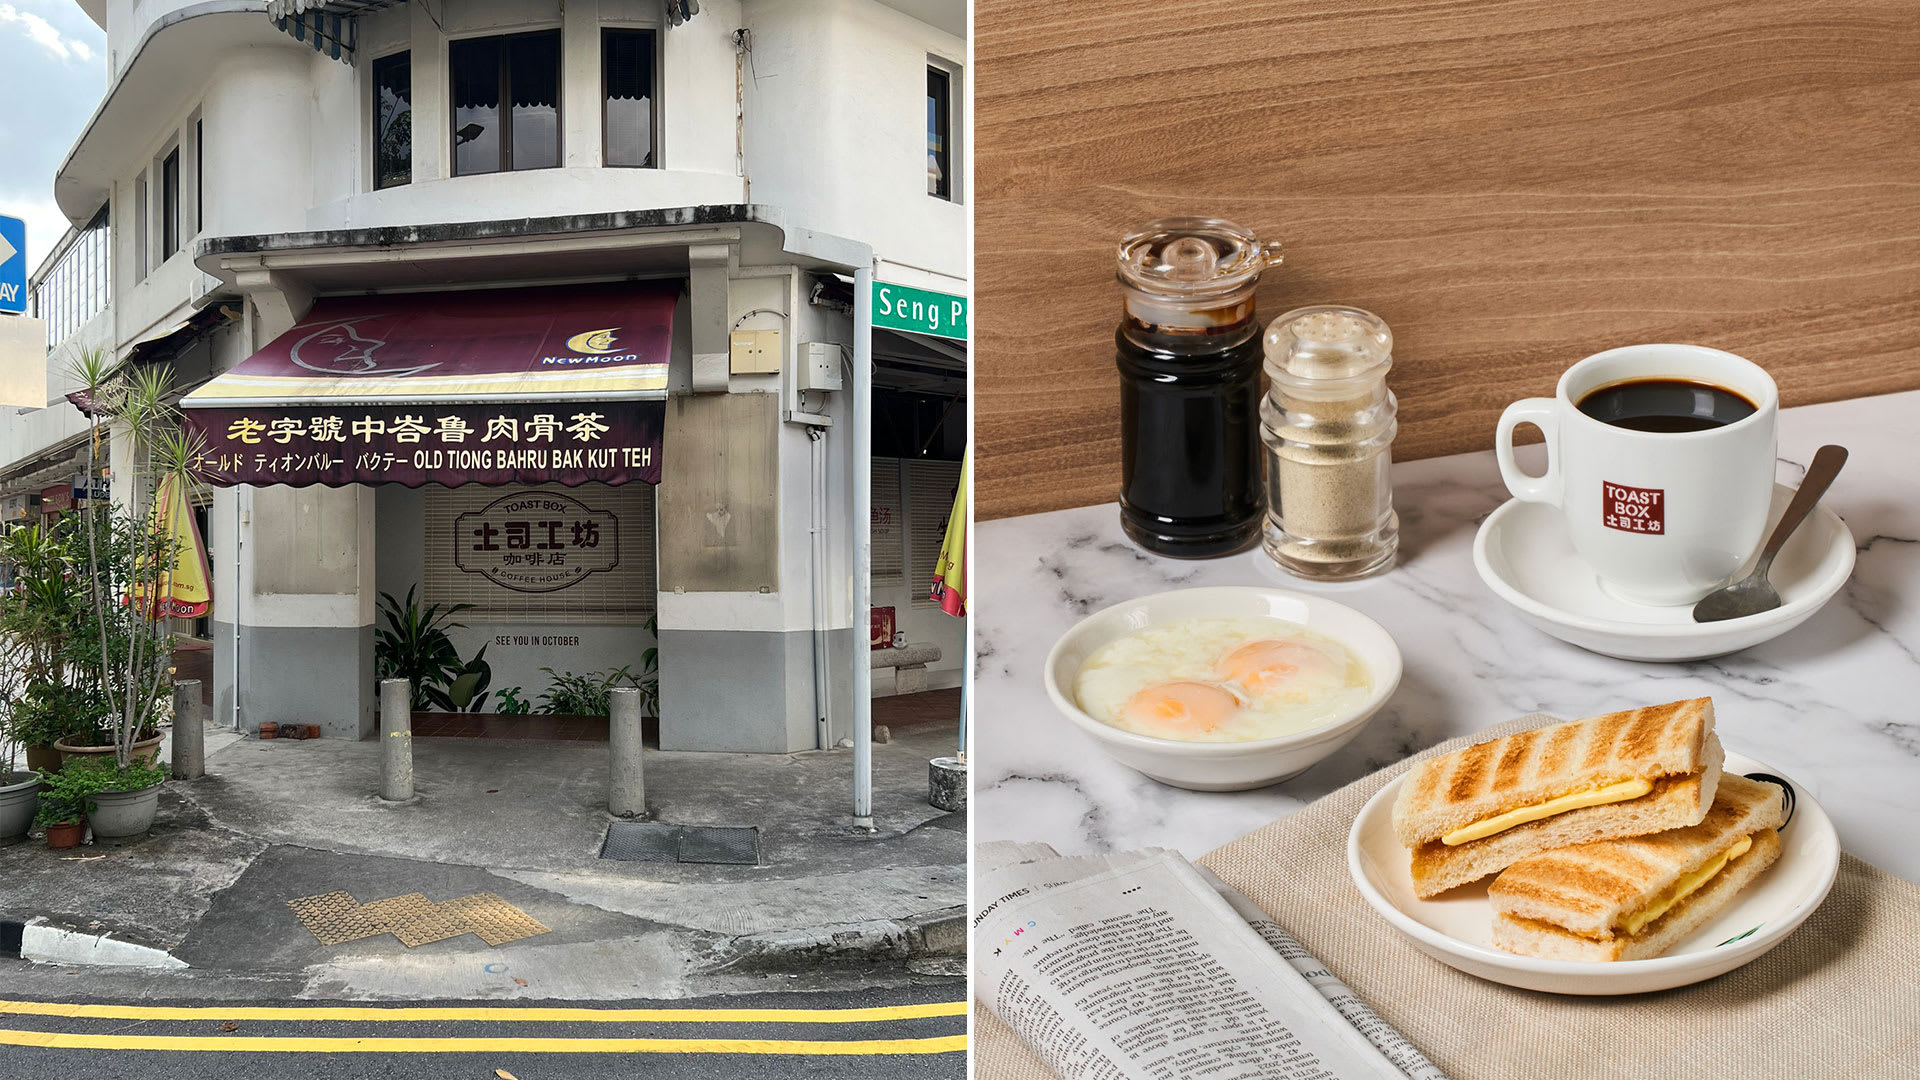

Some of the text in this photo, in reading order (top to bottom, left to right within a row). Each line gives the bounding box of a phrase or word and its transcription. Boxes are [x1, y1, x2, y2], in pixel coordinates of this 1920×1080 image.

[0, 283, 19, 302] AY
[880, 288, 967, 330] Seng P
[227, 412, 610, 444] 老字號中峇魯肉骨茶
[193, 452, 408, 472] オールド ティオンバルー バクテー
[414, 447, 652, 469] OLD TIONG BAHRU BAK KUT TEH
[1606, 485, 1661, 505] TOAST
[503, 500, 567, 514] TOAST BOX
[1615, 501, 1650, 518] BOX
[1607, 514, 1661, 532] 土司工坊
[473, 520, 600, 551] 土司工坊
[503, 552, 567, 566] 咖啡店
[501, 570, 571, 583] COFFEE HOUSE
[495, 635, 579, 646] SEE YOU IN OCTOBER
[998, 888, 1030, 904] TIMES
[993, 920, 1037, 957] C M Y K
